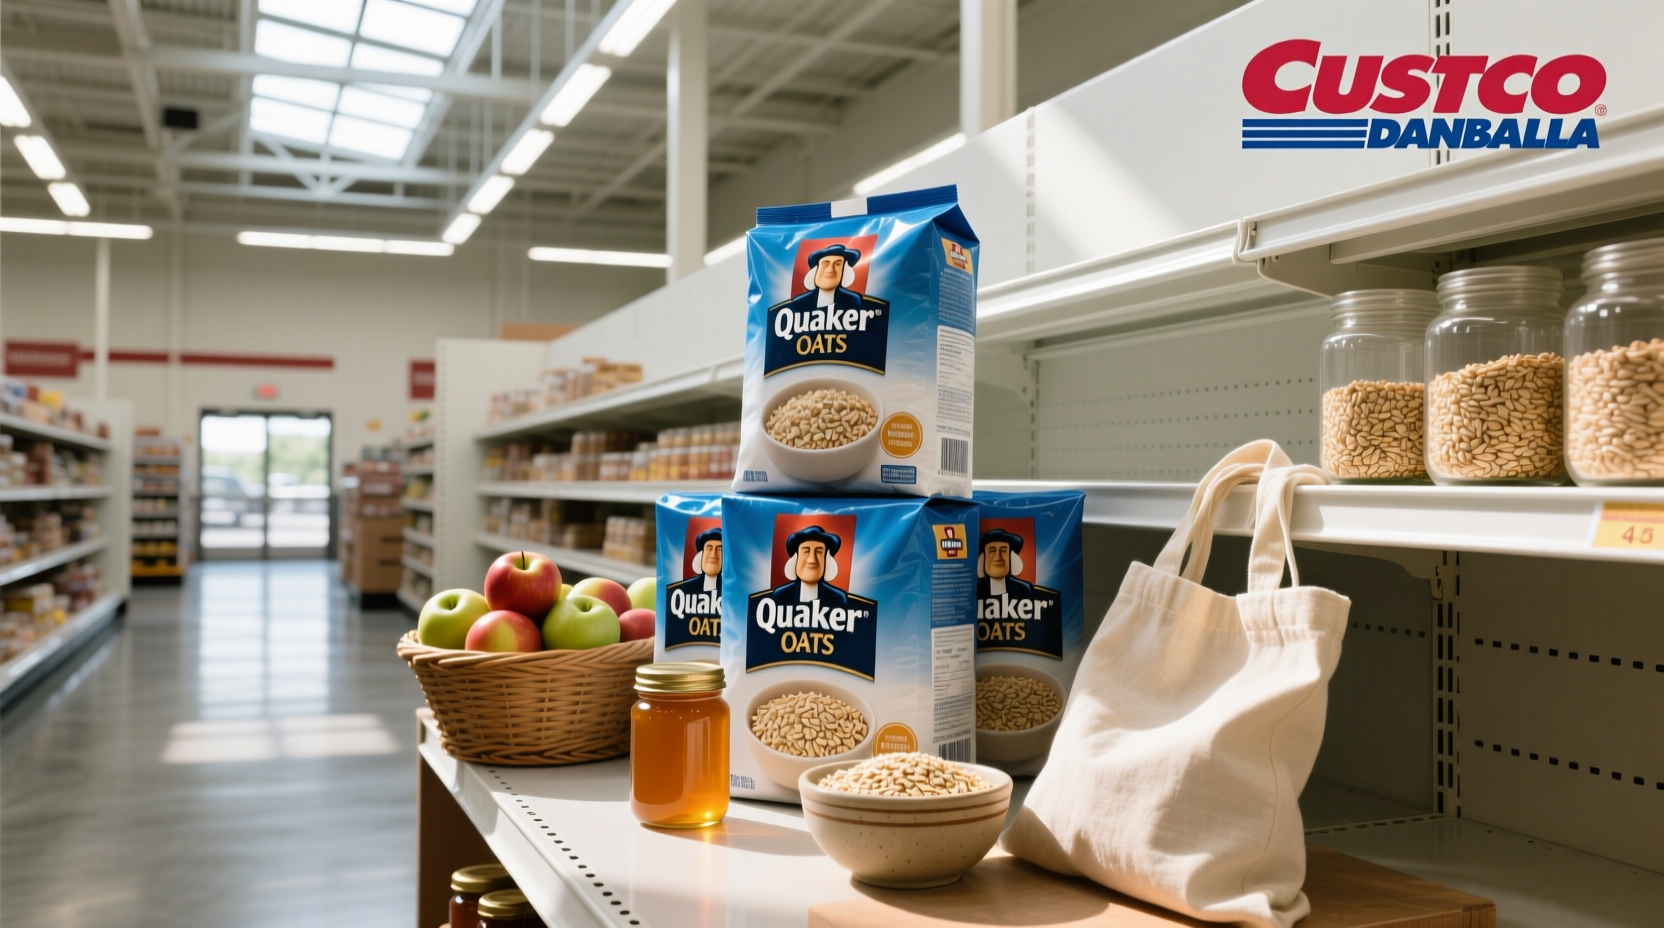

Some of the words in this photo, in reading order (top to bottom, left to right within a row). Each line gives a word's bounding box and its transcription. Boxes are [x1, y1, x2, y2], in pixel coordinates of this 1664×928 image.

[774, 302, 875, 341] Quaker
[796, 333, 847, 355] OATS
[688, 616, 722, 637] OAT
[756, 597, 863, 634] Quaker
[978, 621, 1026, 641] OATS
[781, 631, 834, 655] OATS
